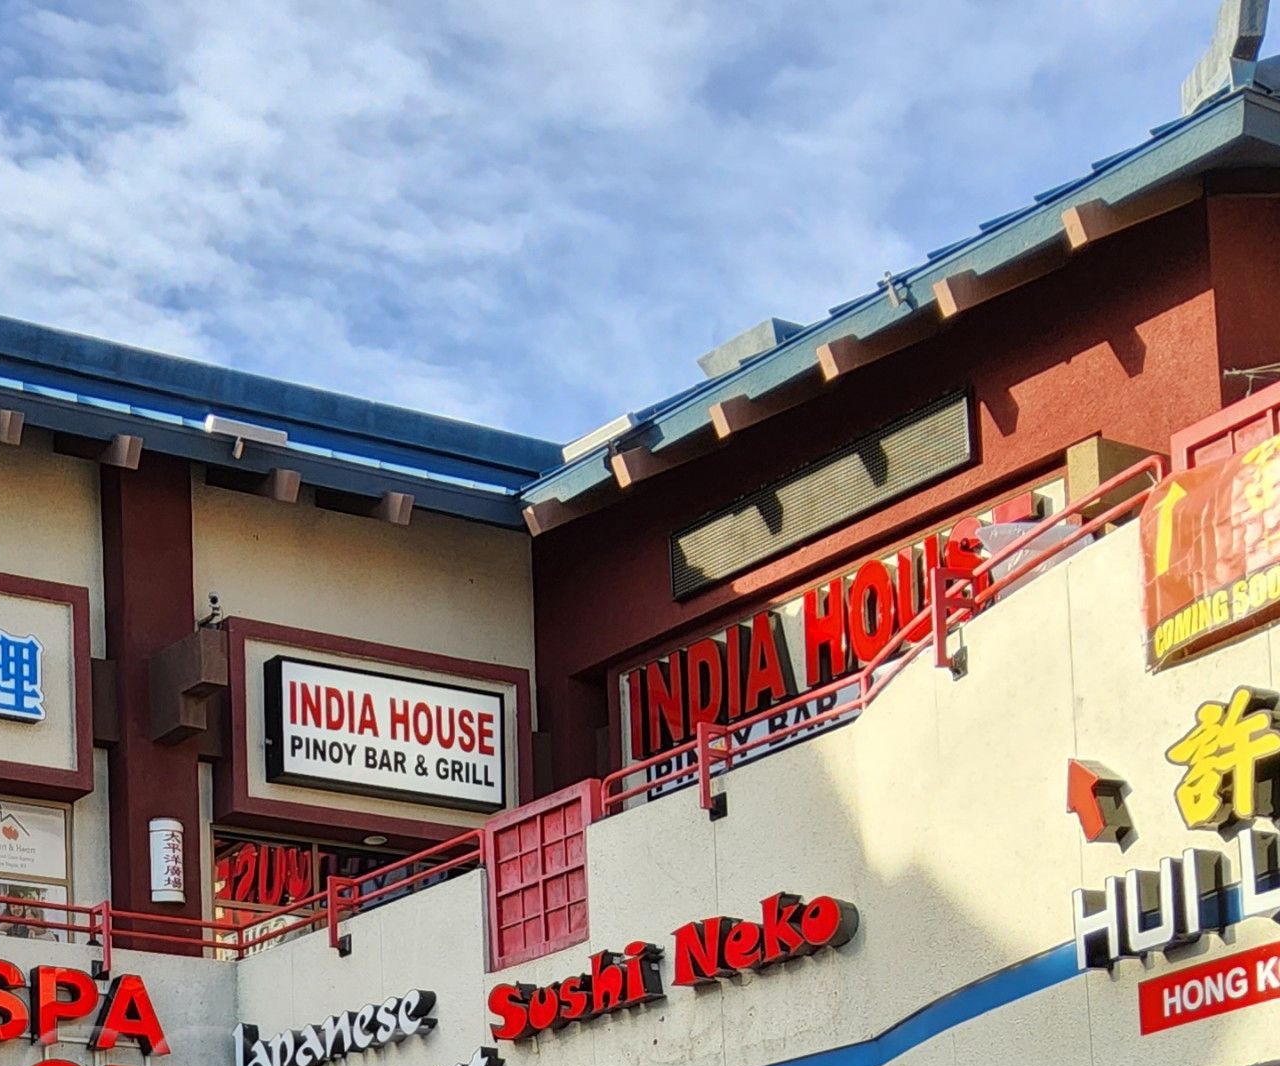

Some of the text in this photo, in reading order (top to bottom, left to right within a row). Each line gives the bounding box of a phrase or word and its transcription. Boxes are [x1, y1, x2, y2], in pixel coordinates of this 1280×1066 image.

[629, 611, 788, 759] INDIA
[803, 517, 995, 688] HOUS
[1154, 590, 1229, 657] COMING
[289, 681, 495, 756] INDIA HOUSE
[290, 735, 495, 787] PINOY BAR & GRILL
[163, 831, 183, 888] 太平洋廣場
[1072, 848, 1199, 970] HUI
[488, 891, 842, 1042] Sushi Neko
[1162, 956, 1280, 1018] HONG K
